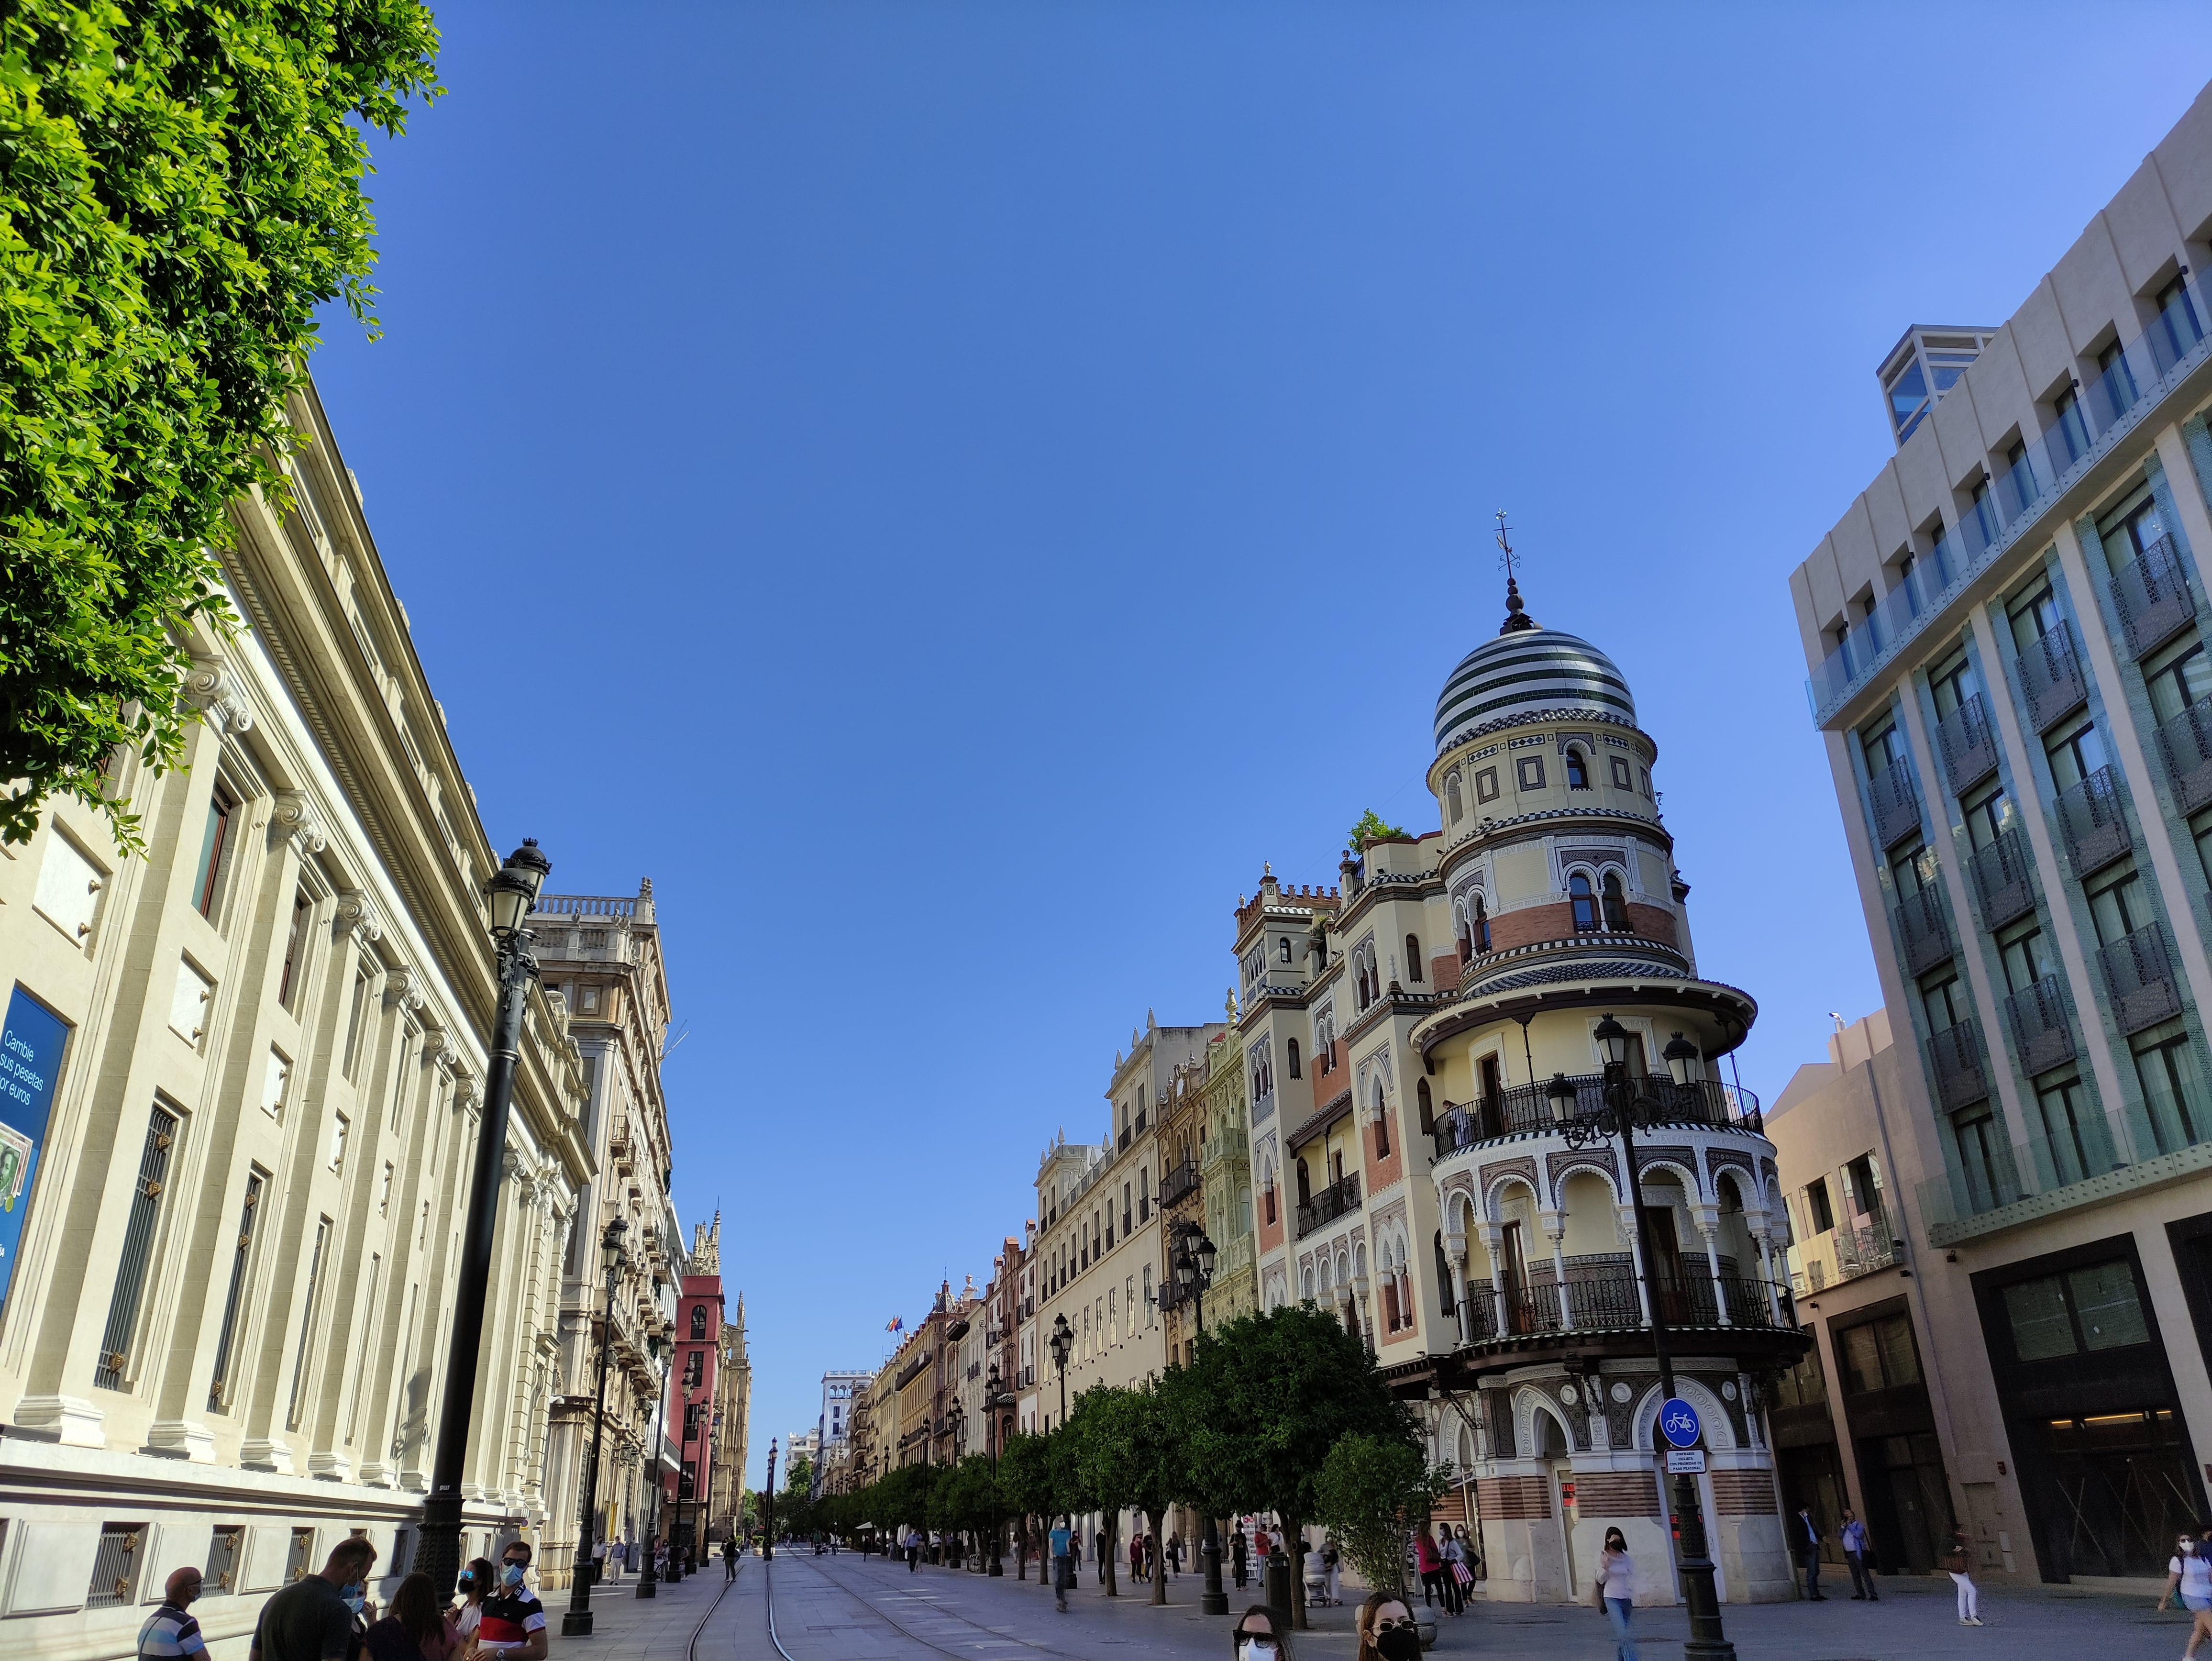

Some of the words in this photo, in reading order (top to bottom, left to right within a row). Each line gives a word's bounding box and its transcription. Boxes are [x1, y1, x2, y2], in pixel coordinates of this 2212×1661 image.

[5, 1030, 33, 1062] Cambie
[0, 1053, 14, 1072] sus
[13, 1063, 43, 1091] pesetas
[0, 1075, 10, 1091] or
[9, 1083, 31, 1106] euros
